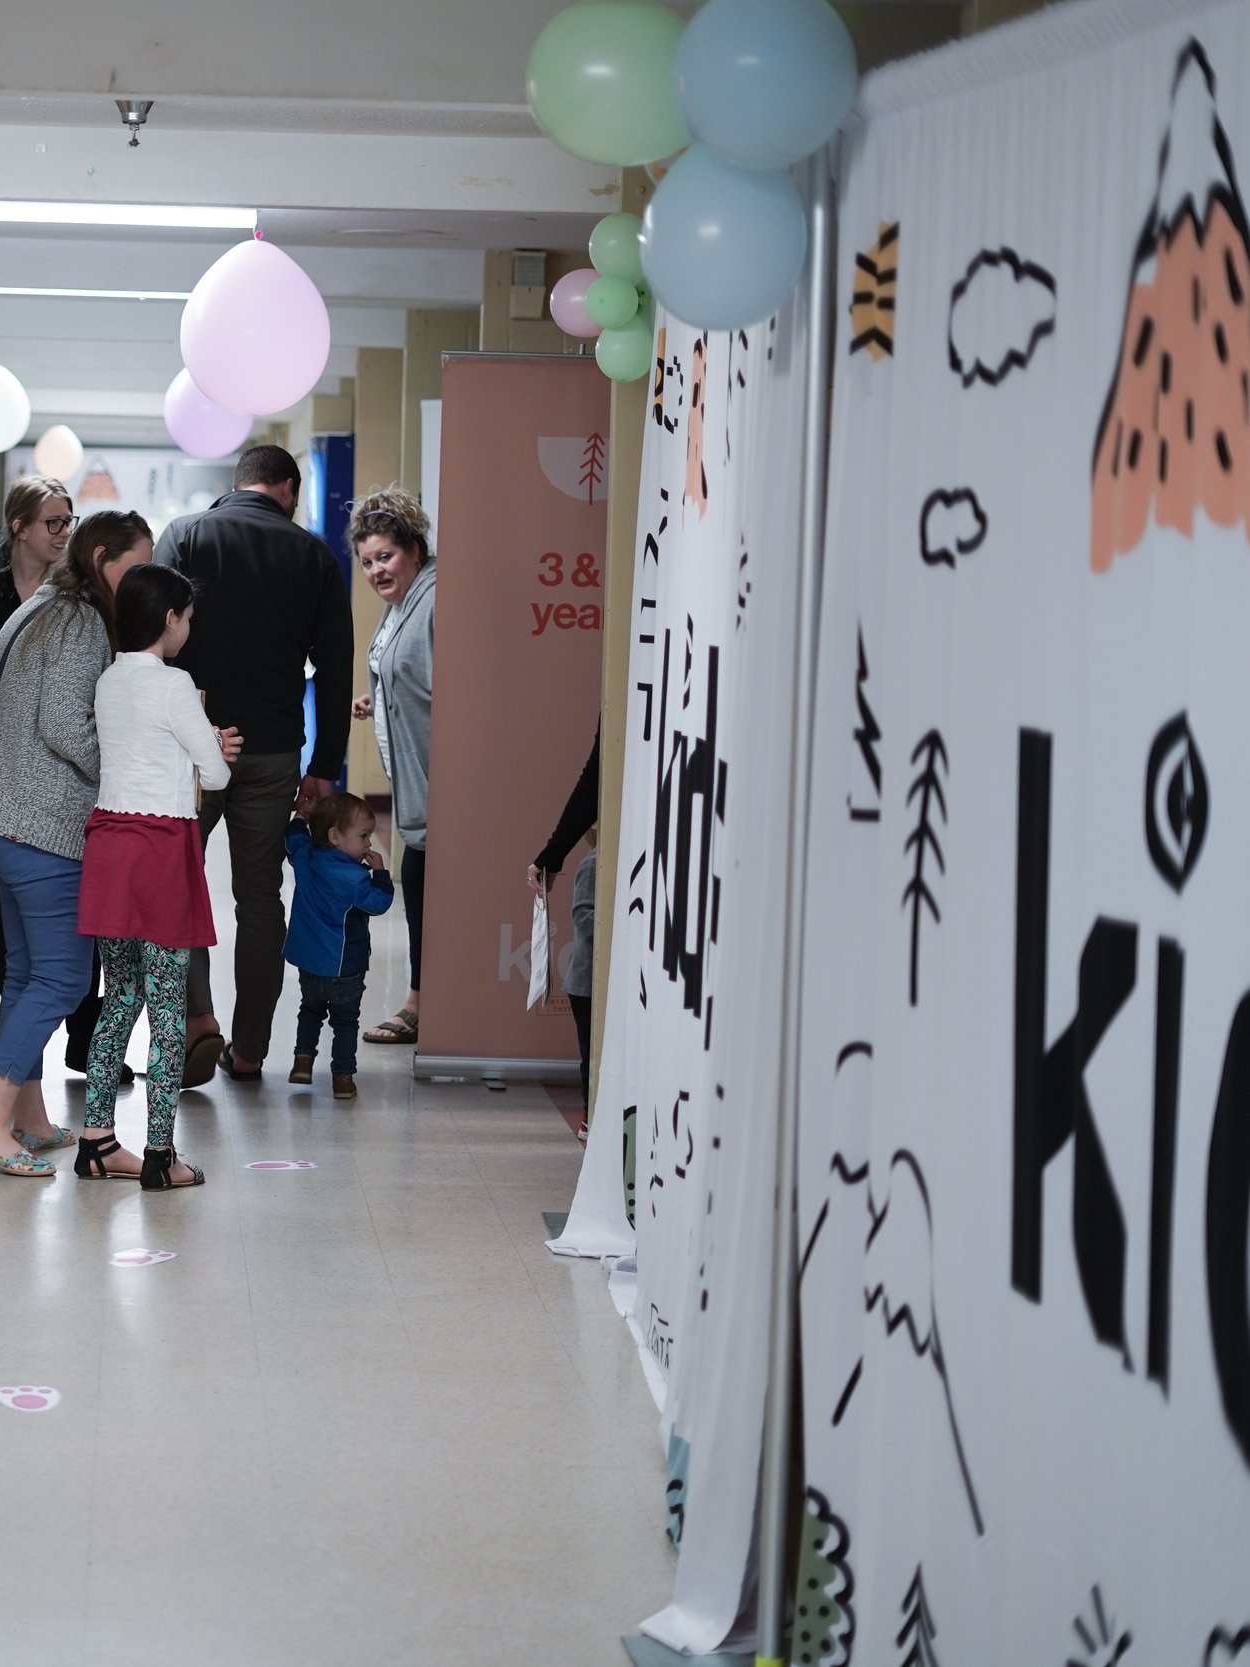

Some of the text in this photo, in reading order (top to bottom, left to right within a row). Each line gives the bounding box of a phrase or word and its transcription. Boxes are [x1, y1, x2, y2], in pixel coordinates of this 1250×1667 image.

[538, 552, 600, 588] 3 &
[531, 602, 604, 636] yea
